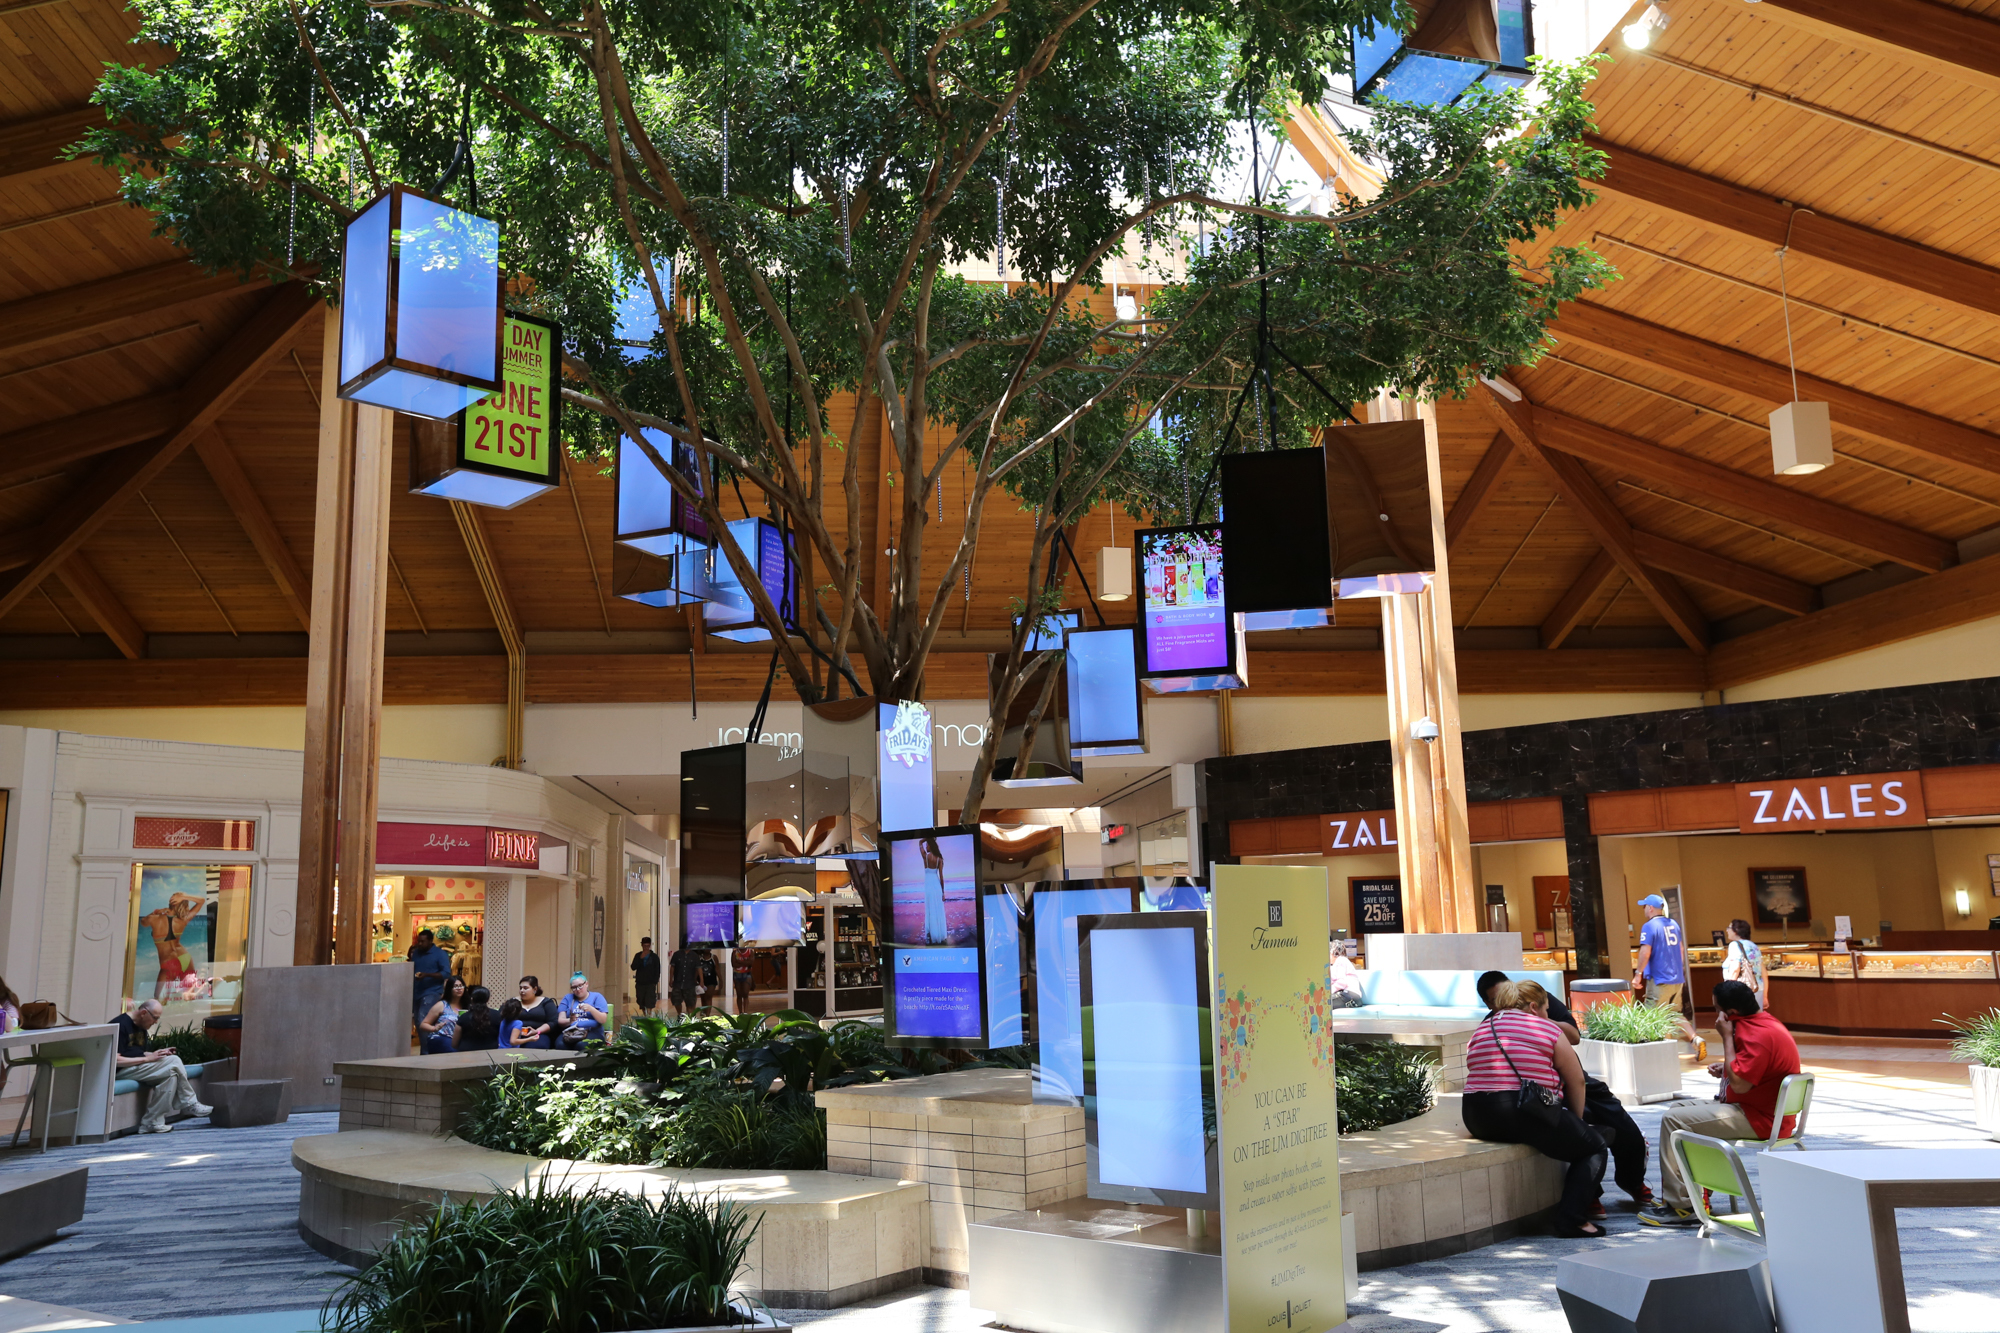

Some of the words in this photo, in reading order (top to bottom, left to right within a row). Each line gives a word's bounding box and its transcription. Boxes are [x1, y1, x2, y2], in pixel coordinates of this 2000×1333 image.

[513, 325, 543, 351] DAY
[503, 346, 543, 368] UMMER
[474, 415, 542, 461] 21ST
[935, 723, 987, 747] ma
[1749, 781, 1908, 824] ZALES
[424, 833, 457, 852] life
[457, 838, 471, 848] is
[490, 830, 538, 862] PINK
[1363, 896, 1378, 904] SAVE
[1378, 896, 1387, 904] UP
[1269, 905, 1281, 922] BE
[1381, 912, 1396, 922] OFF
[1250, 926, 1298, 951] Famous
[1663, 925, 1679, 947] 15
[907, 995, 921, 1003] pretty
[1254, 1090, 1274, 1109] YOU
[1275, 1085, 1295, 1104] CAN
[1297, 1082, 1307, 1099] BE
[1263, 1115, 1271, 1131] A
[1233, 1144, 1249, 1164] ON
[1251, 1138, 1270, 1158] THE
[1272, 1133, 1289, 1153] LJM
[1290, 1122, 1328, 1147] DIGITREE
[1243, 1180, 1255, 1192] Step
[1255, 1173, 1270, 1188] inside
[1271, 1173, 1281, 1183] our
[1281, 1167, 1294, 1183] photo
[1295, 1161, 1310, 1175] booth,
[1310, 1156, 1322, 1170] smile
[1239, 1197, 1250, 1213] and
[1250, 1196, 1266, 1208] create
[1266, 1194, 1271, 1203] a
[1271, 1190, 1285, 1203] super
[1285, 1182, 1298, 1197] selfie
[1298, 1178, 1309, 1192] with
[1236, 1231, 1249, 1243] Follow
[1256, 1222, 1278, 1236] instructions
[1247, 1244, 1257, 1255] your
[1263, 1237, 1274, 1246] move
[1274, 1229, 1288, 1242] through
[1267, 1311, 1287, 1327] LOUIS
[1291, 1298, 1312, 1316] JOLIET
